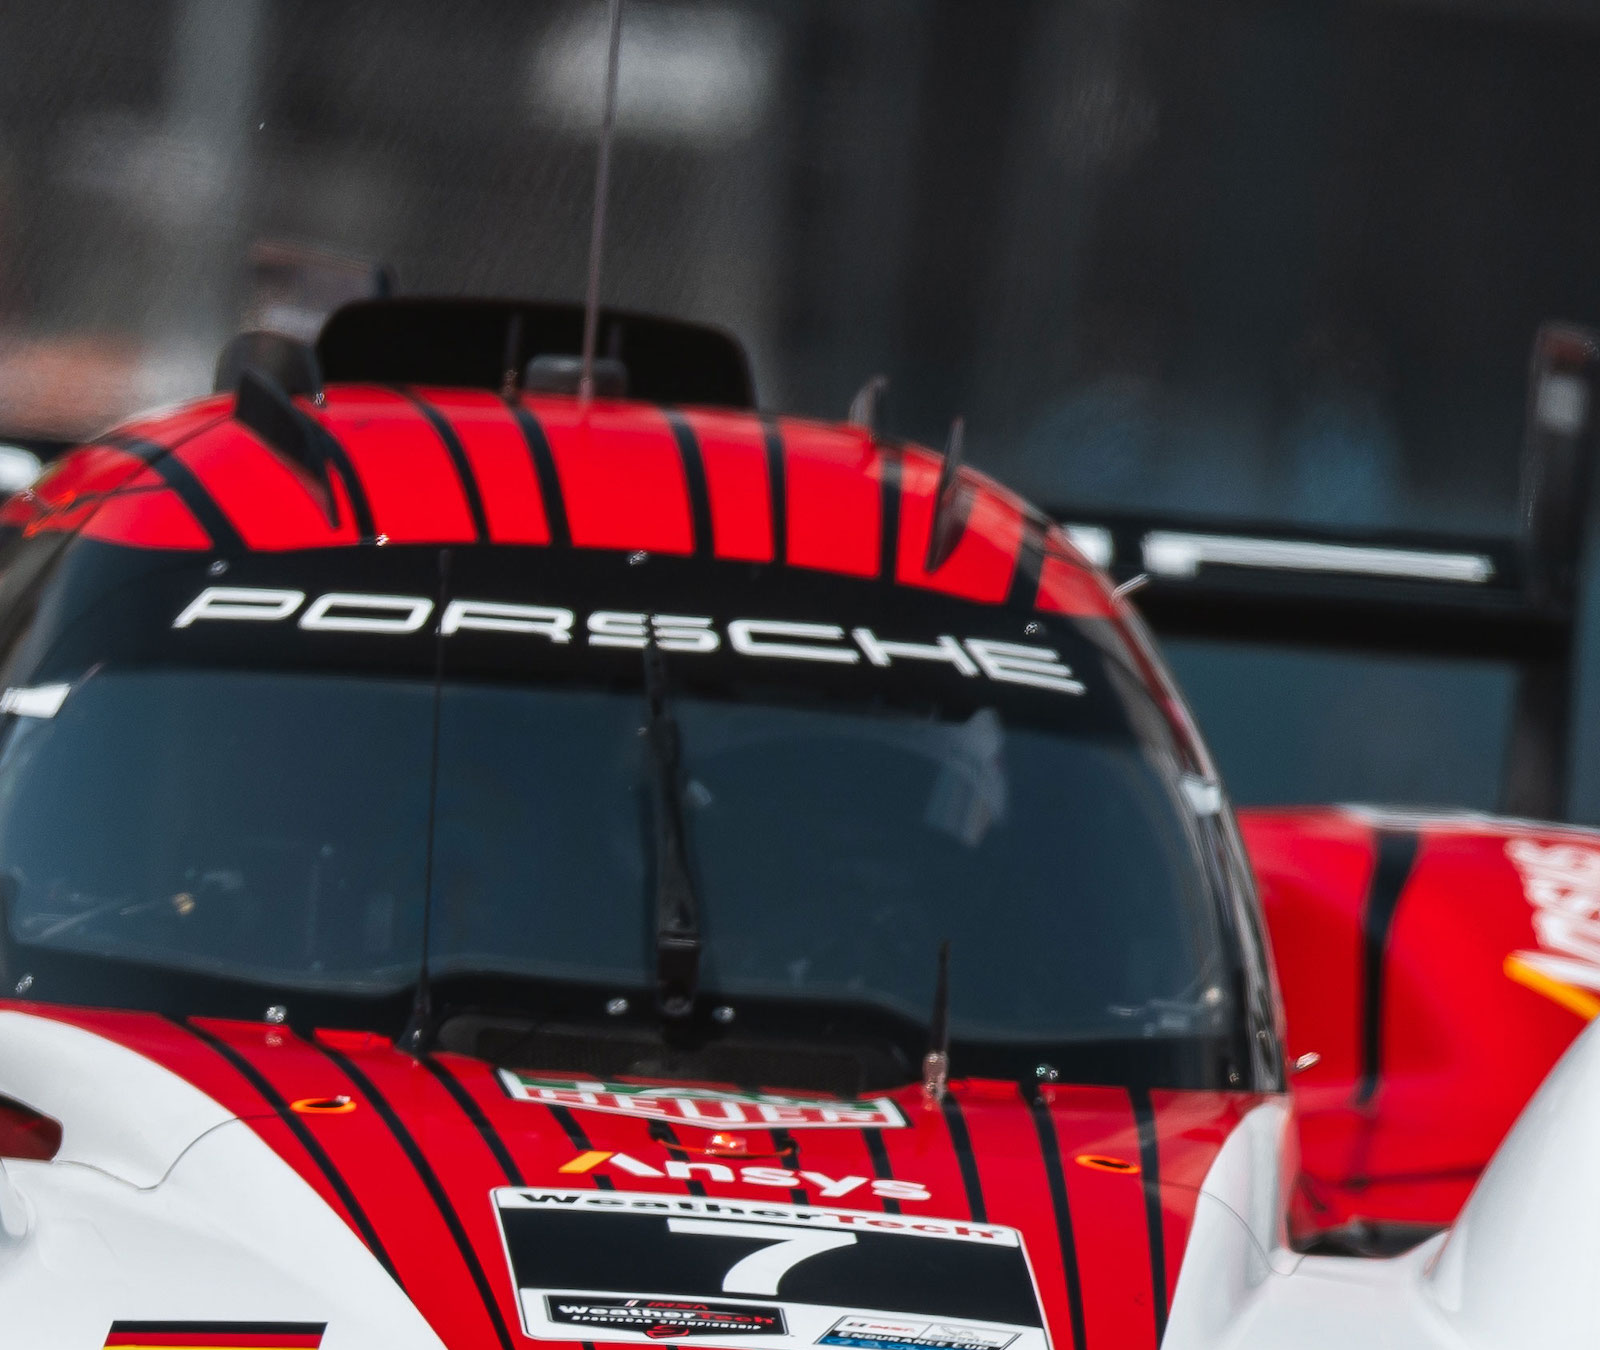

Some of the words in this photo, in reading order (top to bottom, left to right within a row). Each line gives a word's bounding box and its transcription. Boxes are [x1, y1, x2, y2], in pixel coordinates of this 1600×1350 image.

[172, 585, 1086, 695] PORSCHE
[557, 1150, 932, 1201] Ansys
[519, 1193, 1000, 1240] WeatherTech
[666, 1216, 859, 1297] 7
[558, 1304, 775, 1325] WeatherTech
[645, 1300, 710, 1311] IMSA
[837, 1330, 948, 1348] ENDURANCE
